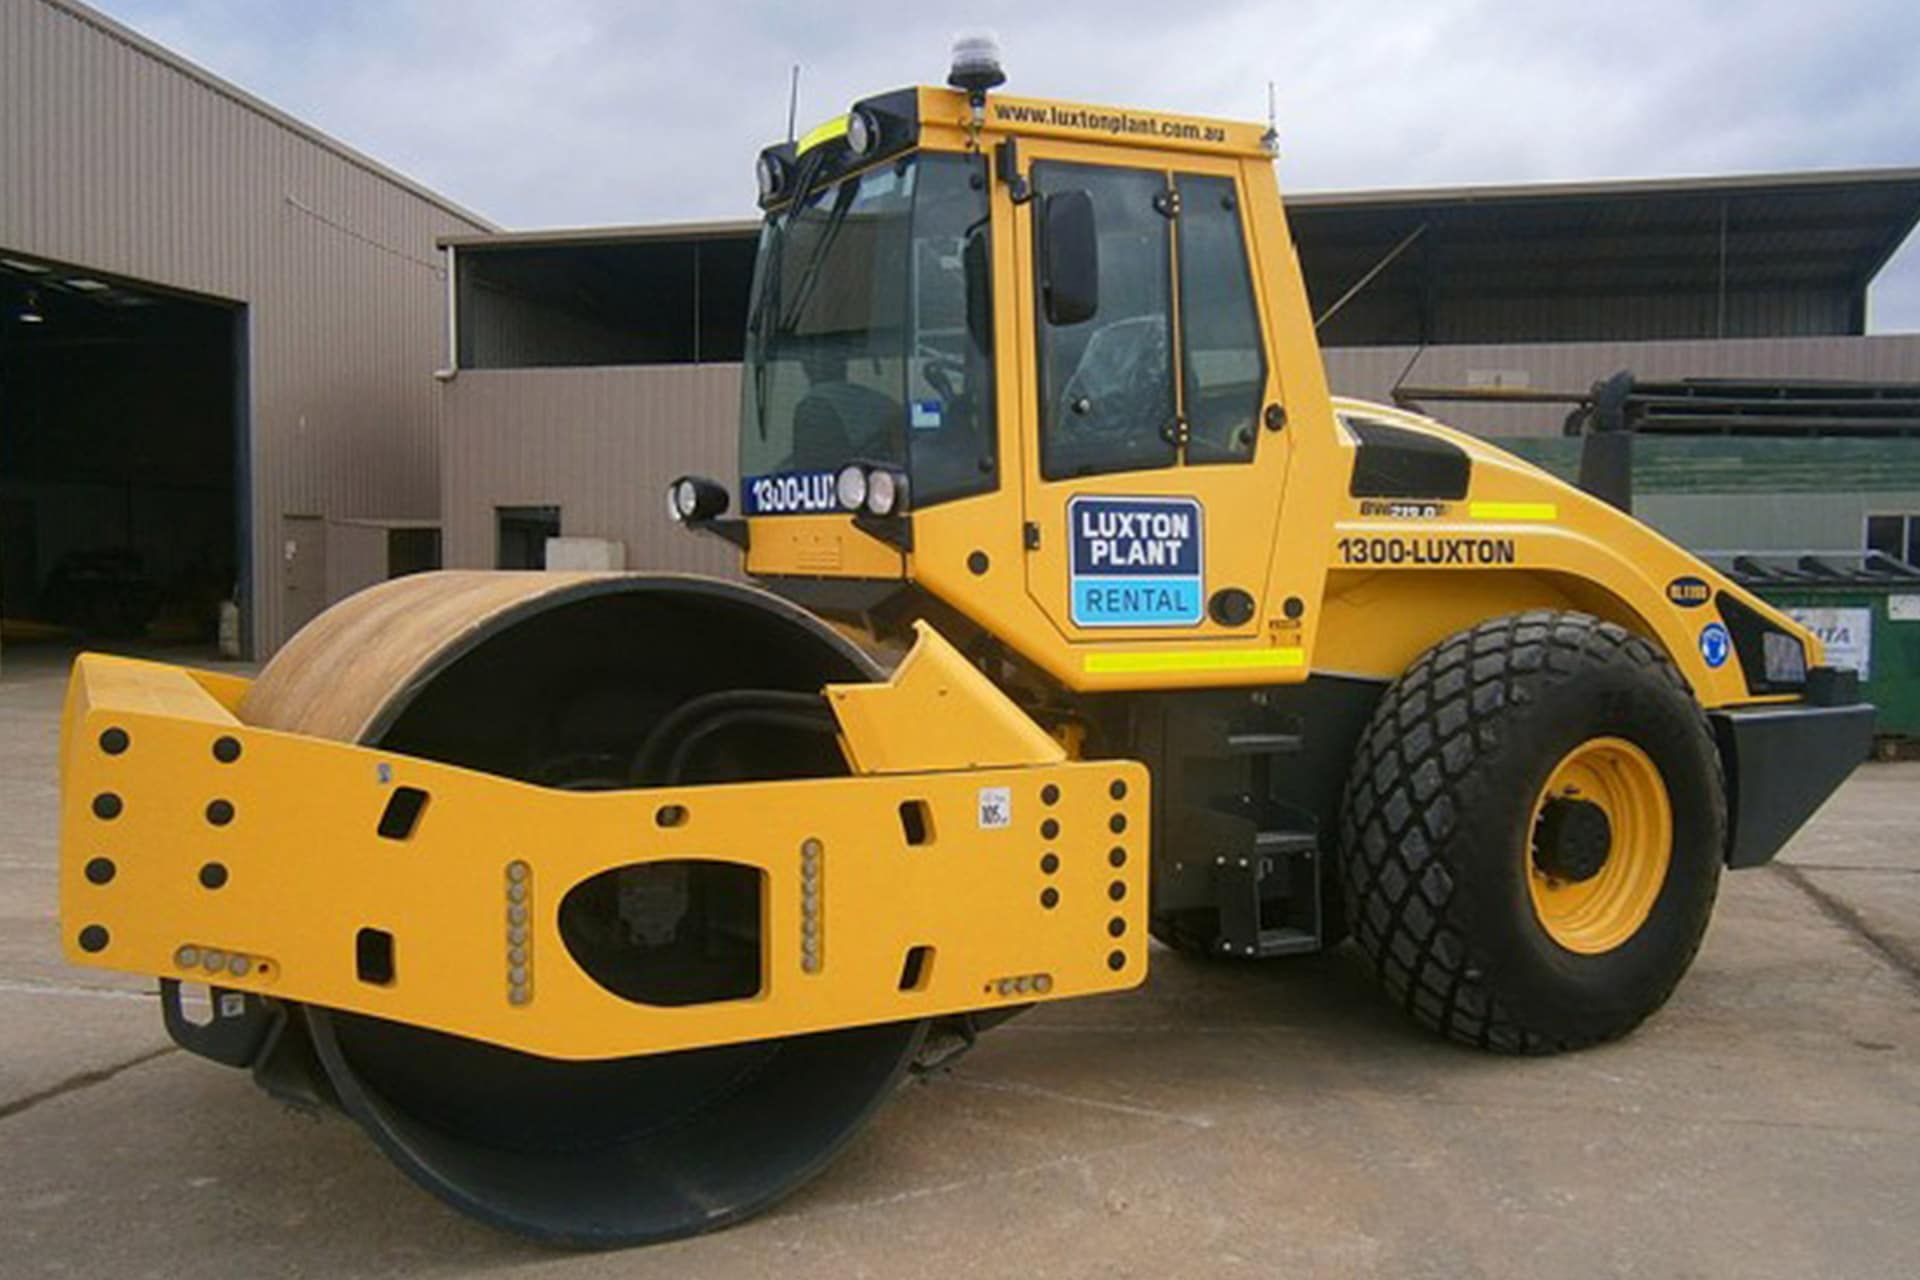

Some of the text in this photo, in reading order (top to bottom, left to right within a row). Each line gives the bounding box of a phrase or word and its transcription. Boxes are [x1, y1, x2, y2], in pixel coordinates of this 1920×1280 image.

[994, 104, 1225, 142] www.luxtonplant.com.au
[1082, 511, 1189, 539] LUXTON
[1091, 540, 1182, 566] PLANT
[1338, 538, 1515, 564] 1300-LUXTON
[1086, 588, 1189, 612] RENTAL
